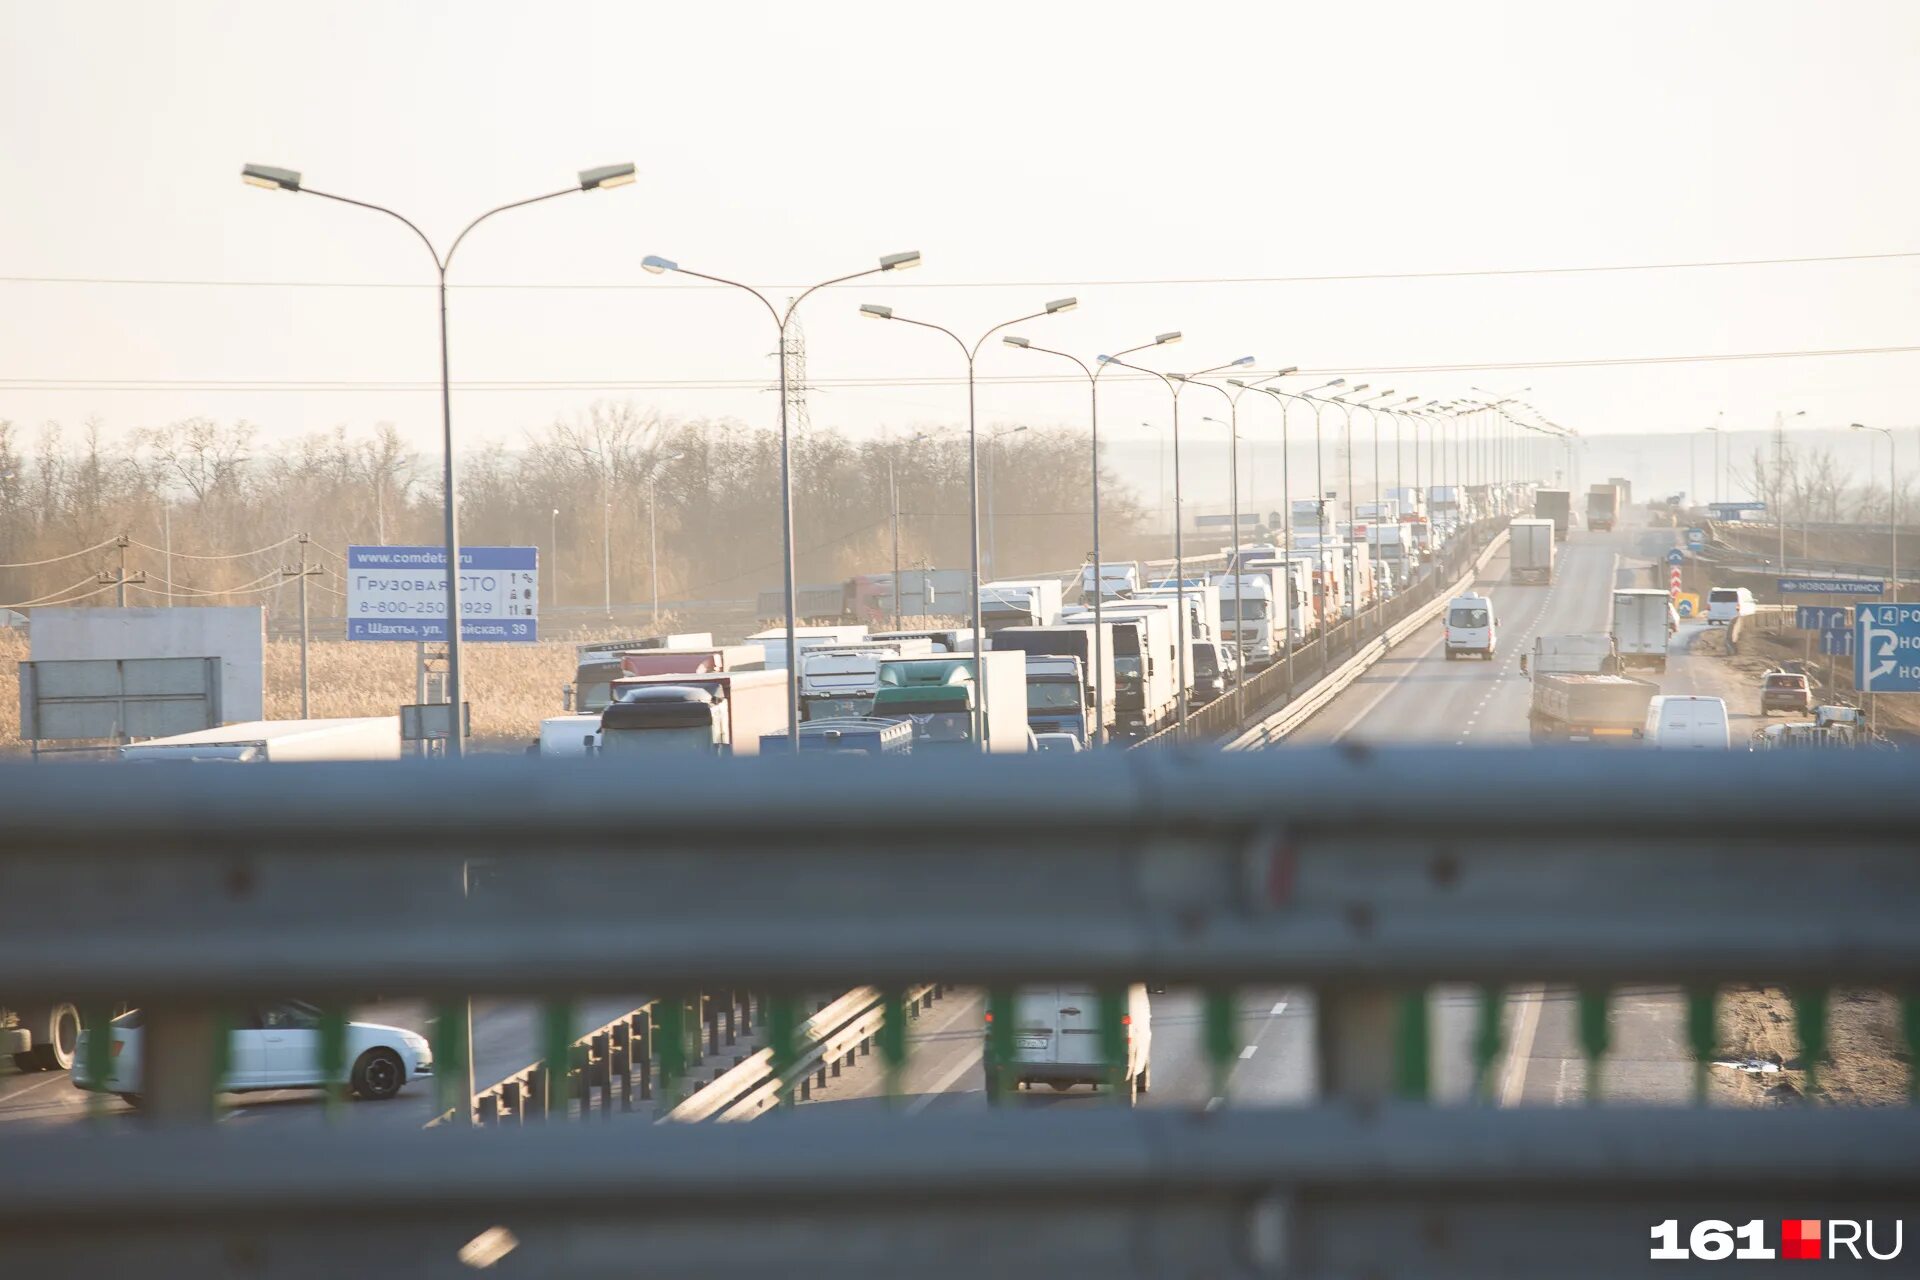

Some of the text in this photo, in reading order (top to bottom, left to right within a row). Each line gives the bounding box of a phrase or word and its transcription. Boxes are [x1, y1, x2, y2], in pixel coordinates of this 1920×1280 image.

[357, 553, 473, 563] www.comdetaru
[459, 576, 496, 592] СТО
[360, 601, 492, 614] 8-800-250929
[1883, 610, 1893, 622] 4
[459, 623, 507, 636] айская,
[511, 623, 527, 635] 39
